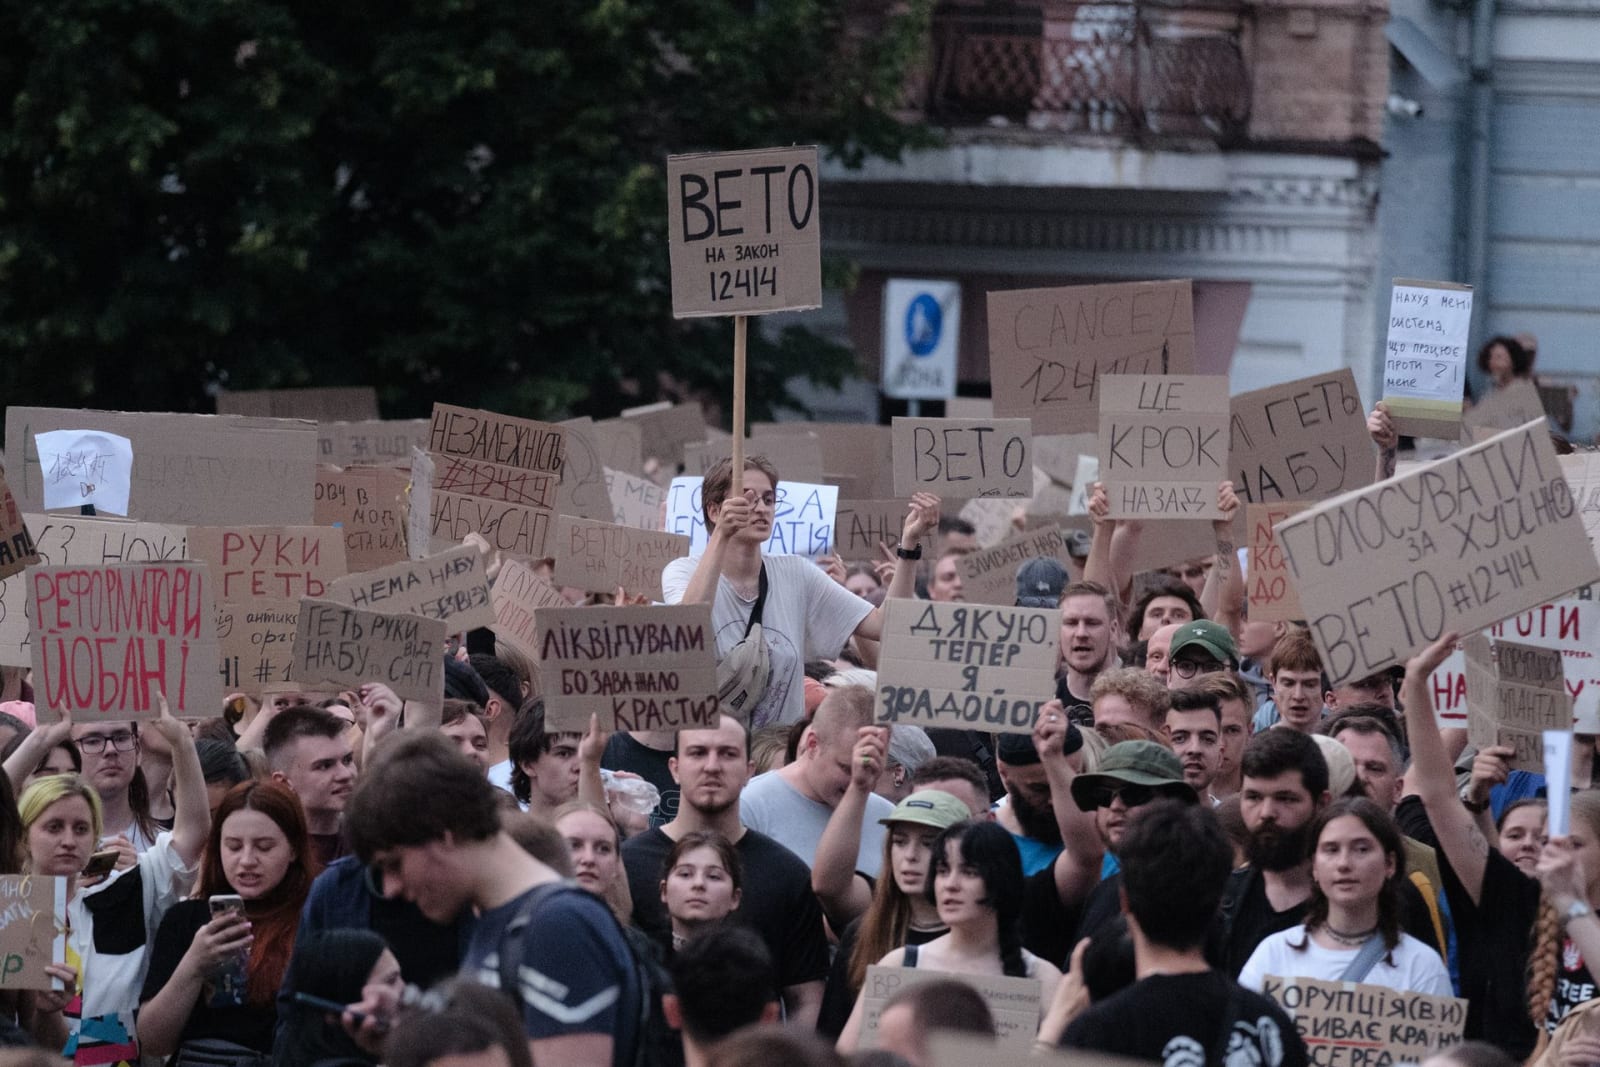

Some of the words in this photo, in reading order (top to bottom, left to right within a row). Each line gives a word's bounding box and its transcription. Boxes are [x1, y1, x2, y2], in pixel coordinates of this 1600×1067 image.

[680, 163, 814, 243] ВЕТО
[705, 247, 726, 263] НА
[735, 243, 779, 261] ЗАКОН
[710, 266, 777, 301] 12414
[1014, 289, 1192, 350] CANCEL
[1138, 382, 1184, 413] ЦЕ
[1264, 380, 1358, 437] ГЕТЬ
[430, 411, 561, 471] НЕЗАЛЕЖНІСТЬ
[913, 427, 1025, 482] ВЕТО
[1109, 423, 1220, 469] КРОК
[1122, 486, 1205, 514] НАЗАД
[1280, 429, 1544, 578] ГОЛОСУВАТИ
[222, 532, 320, 567] РУКИ
[496, 507, 549, 556] САП
[1406, 530, 1436, 562] ЗА
[224, 570, 325, 597] ГЕТЬ
[350, 570, 421, 607] НЕМА
[429, 555, 476, 585] НАБУ
[34, 567, 202, 639] РЕФОРМАТОРИ
[308, 605, 363, 640] ГЕТЬ
[371, 615, 419, 642] РУКИ
[1313, 570, 1445, 684] ВЕТО
[1448, 544, 1541, 614] #12414
[403, 640, 433, 659] ВІД
[541, 620, 705, 661] ЛІКВІДУВАЛИ
[929, 638, 1021, 667] ТЕПЕР
[41, 629, 190, 712] ЙОБАНІ
[305, 639, 370, 677] НАБУ
[388, 656, 434, 687] САП
[561, 669, 588, 695] БО
[961, 665, 980, 692] Я
[612, 695, 720, 731] КРАСТИ?
